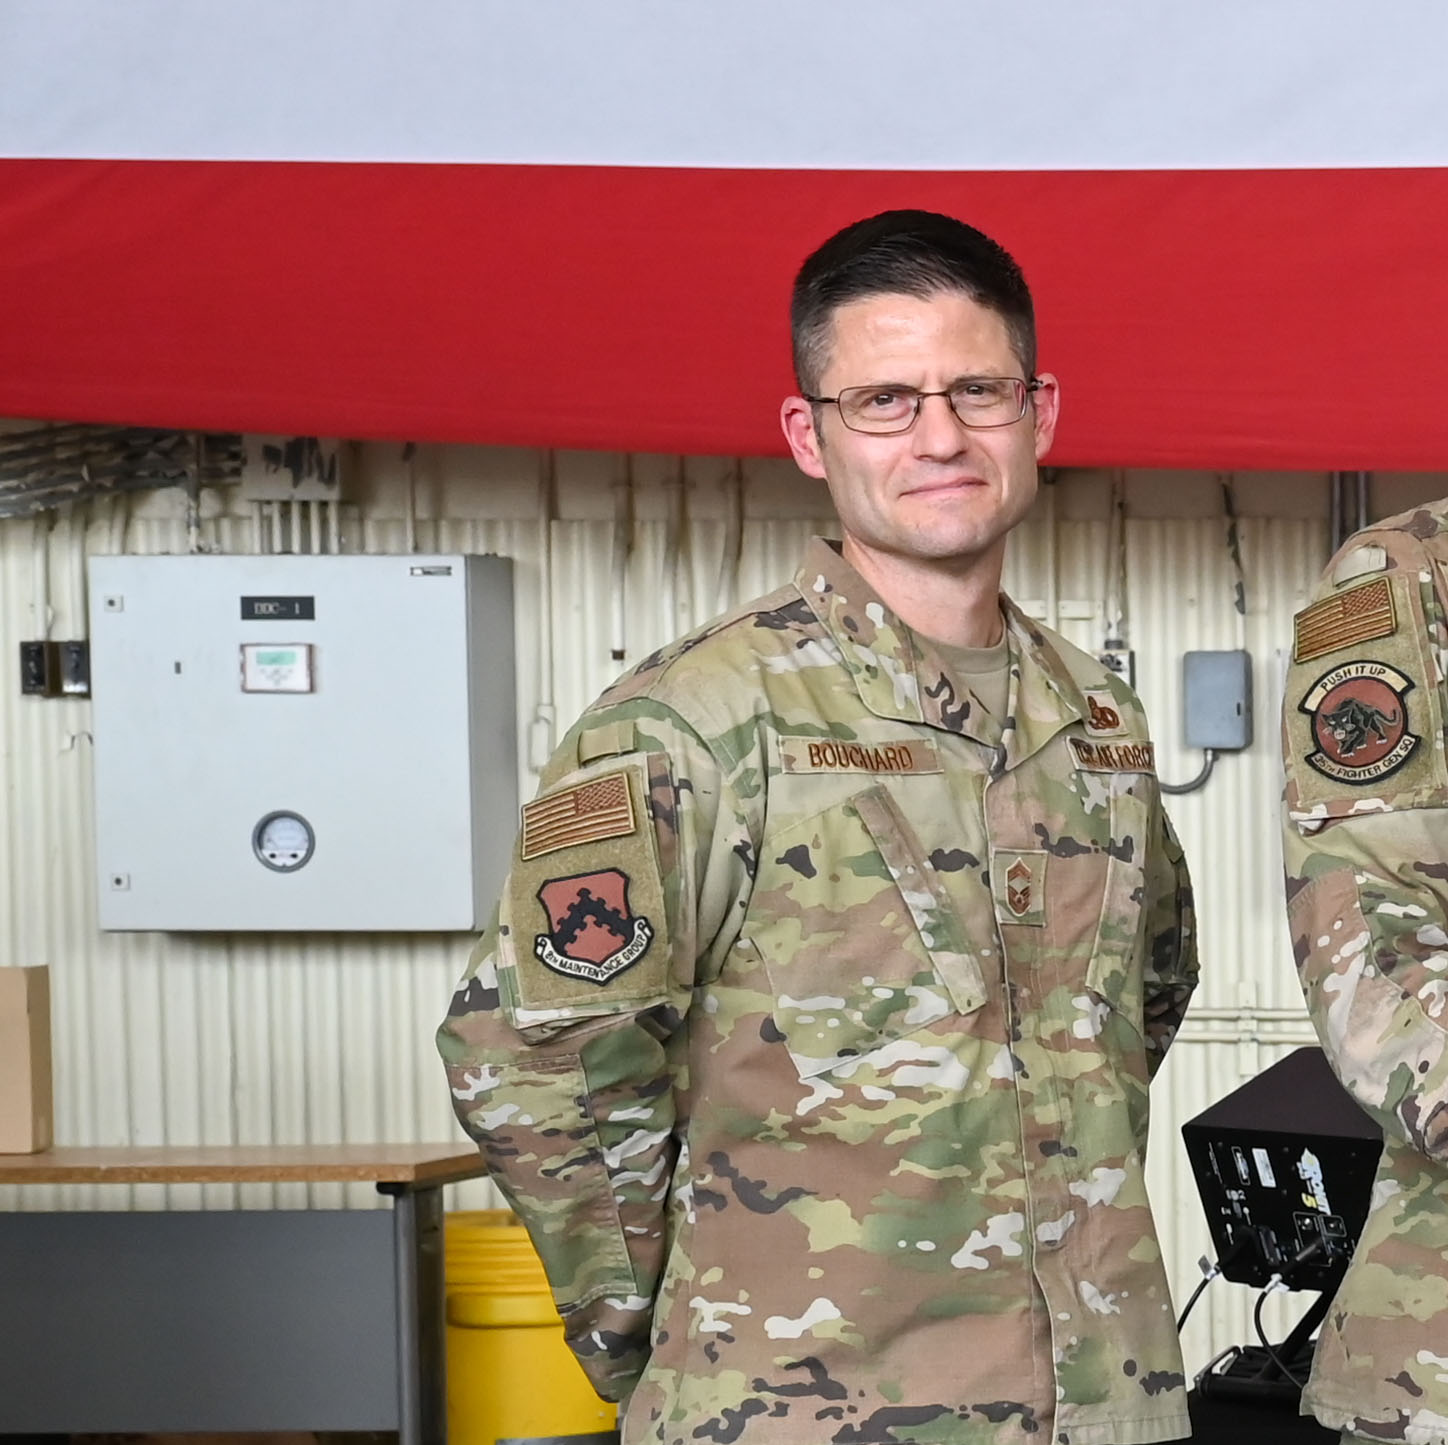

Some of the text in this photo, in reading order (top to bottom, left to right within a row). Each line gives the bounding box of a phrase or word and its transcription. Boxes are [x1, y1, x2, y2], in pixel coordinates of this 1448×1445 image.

[1320, 665, 1386, 692] PUSH IT UP
[808, 743, 914, 772] BOUCHARD
[1336, 765, 1382, 779] FIGHTER
[1382, 752, 1403, 769] GEN
[1400, 738, 1413, 752] SQ
[559, 956, 625, 979] MAINTENANCE
[622, 934, 647, 961] GROUP
